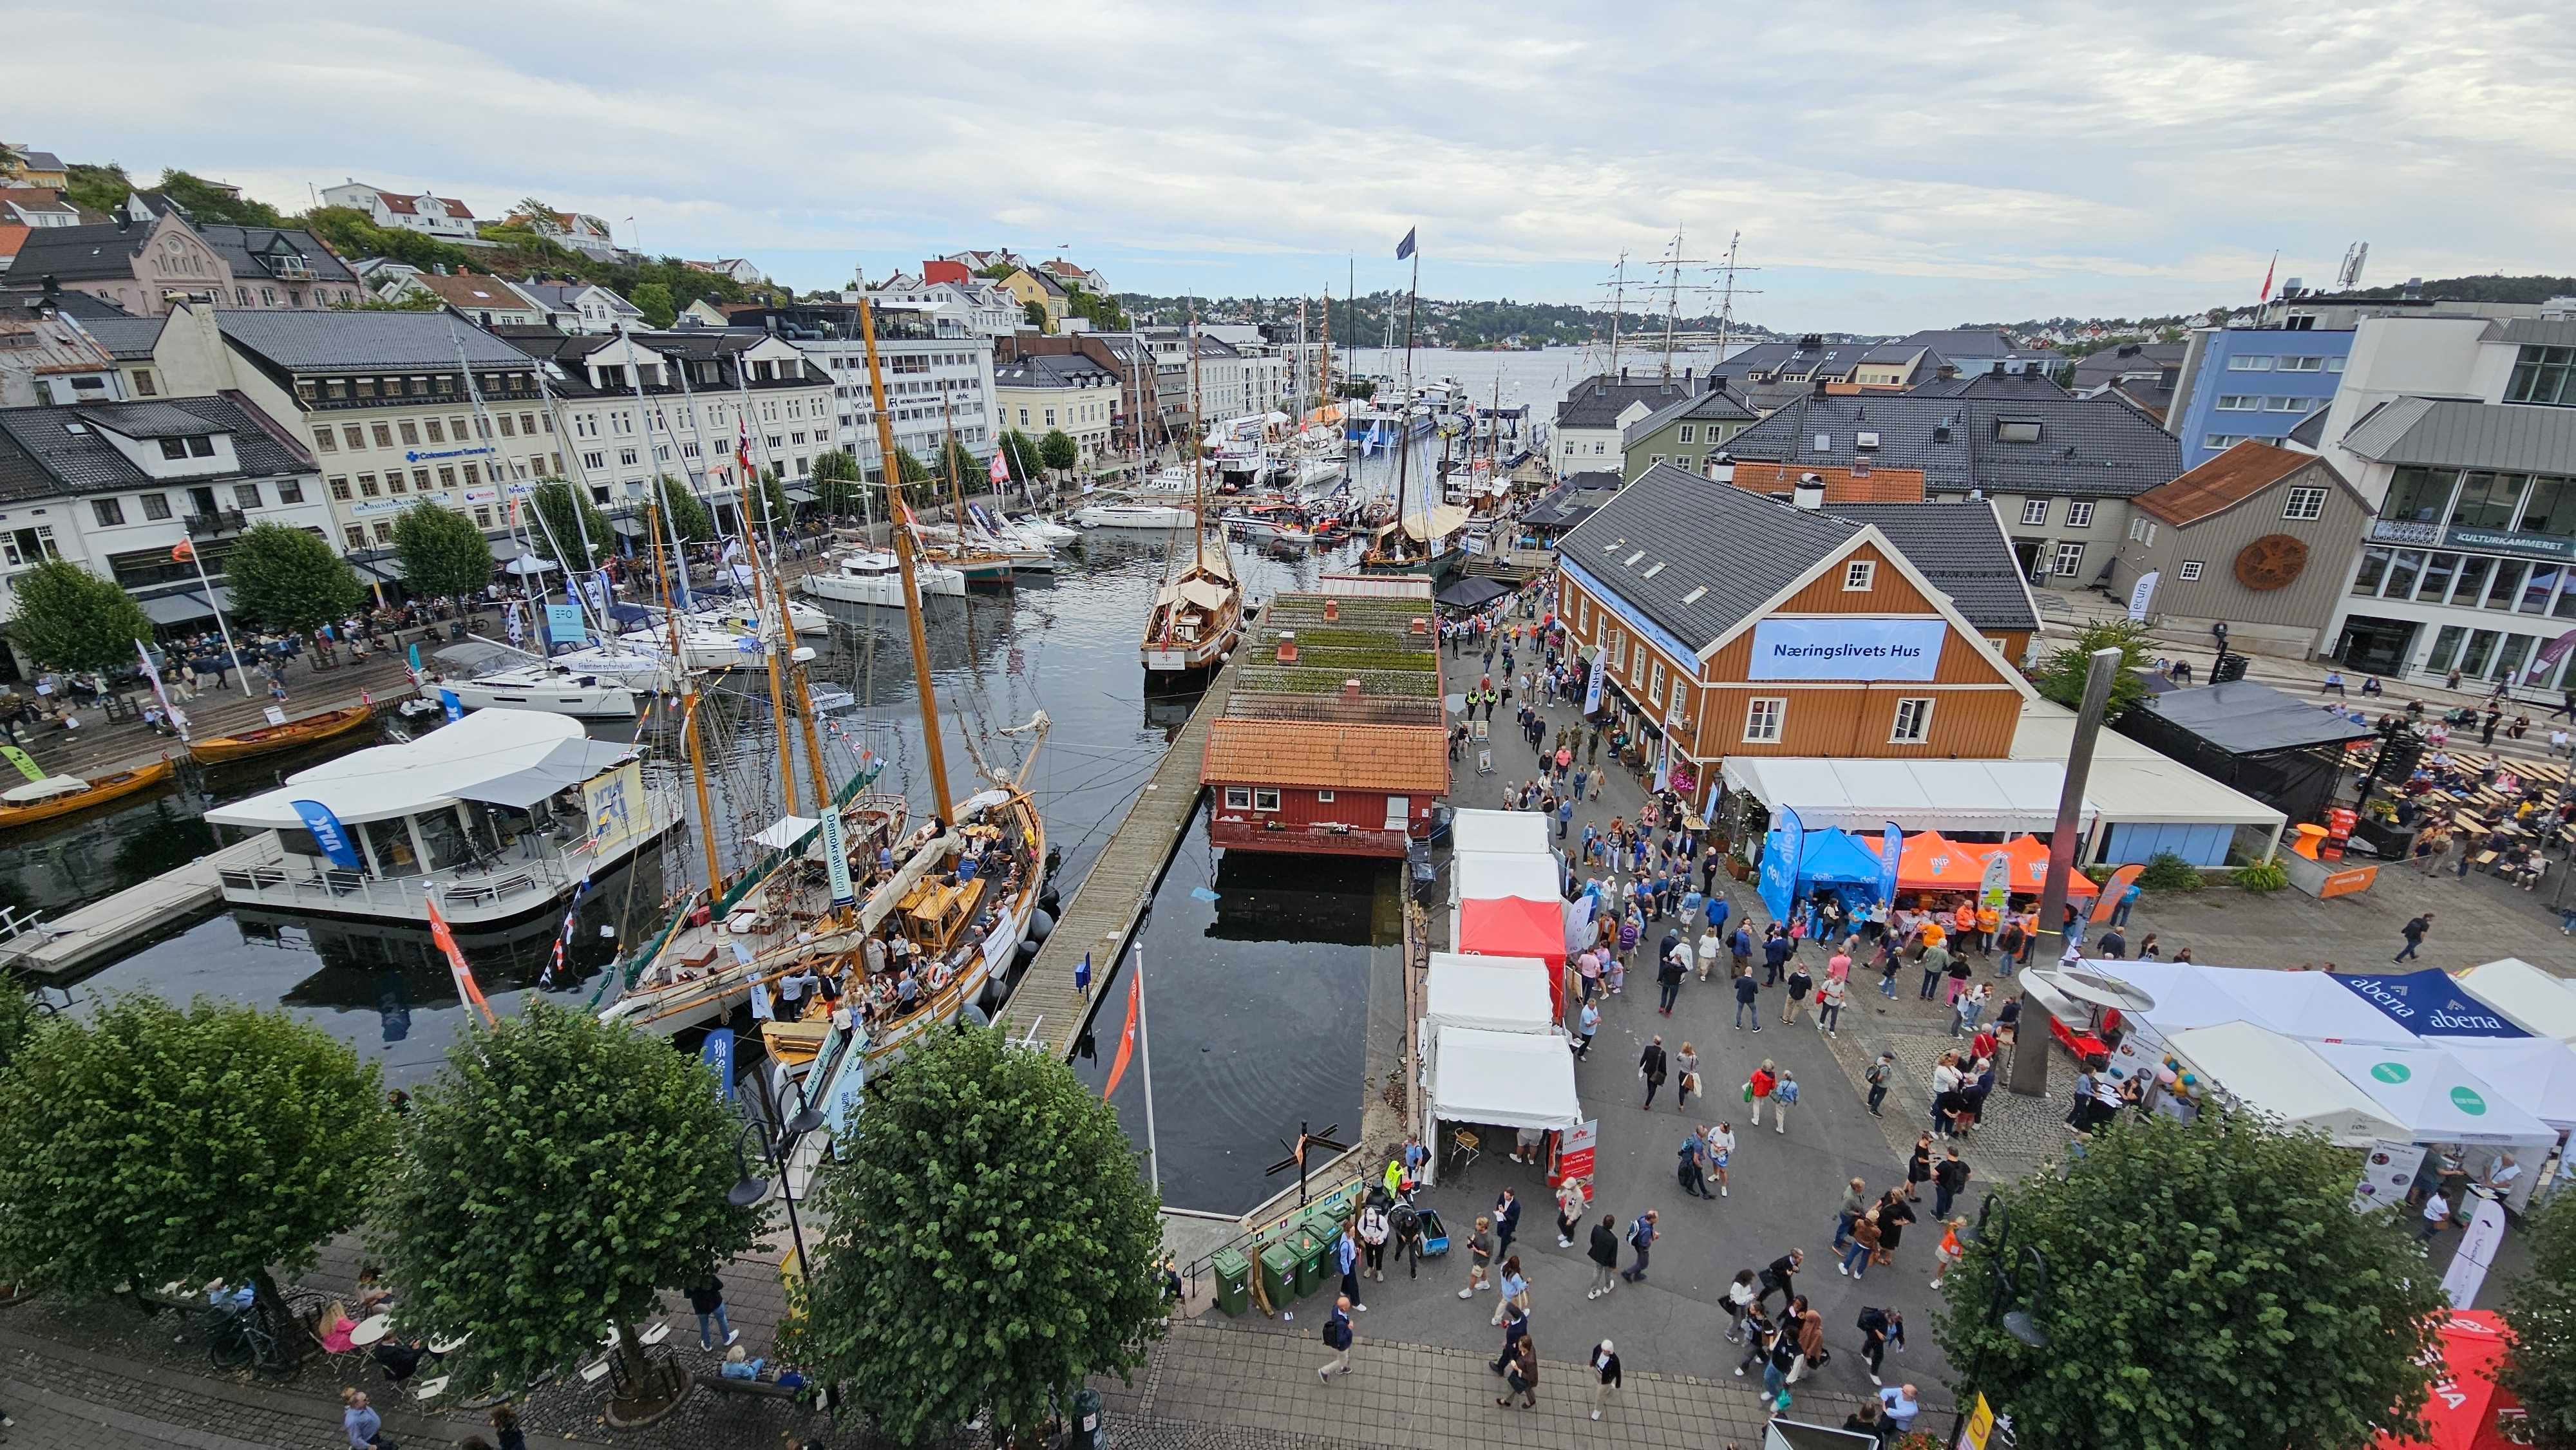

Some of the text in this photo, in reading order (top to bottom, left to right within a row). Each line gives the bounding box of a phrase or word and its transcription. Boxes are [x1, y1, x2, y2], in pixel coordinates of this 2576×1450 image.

[2457, 532, 2564, 551] KULTURKAMMERET
[2133, 583, 2148, 610] ecura
[1774, 644, 1920, 659] Næringslivets Hus
[1592, 664, 1602, 688] NHO
[1931, 858, 1949, 867] INP
[2350, 978, 2415, 1018] aberia
[2430, 1010, 2503, 1029] aberia
